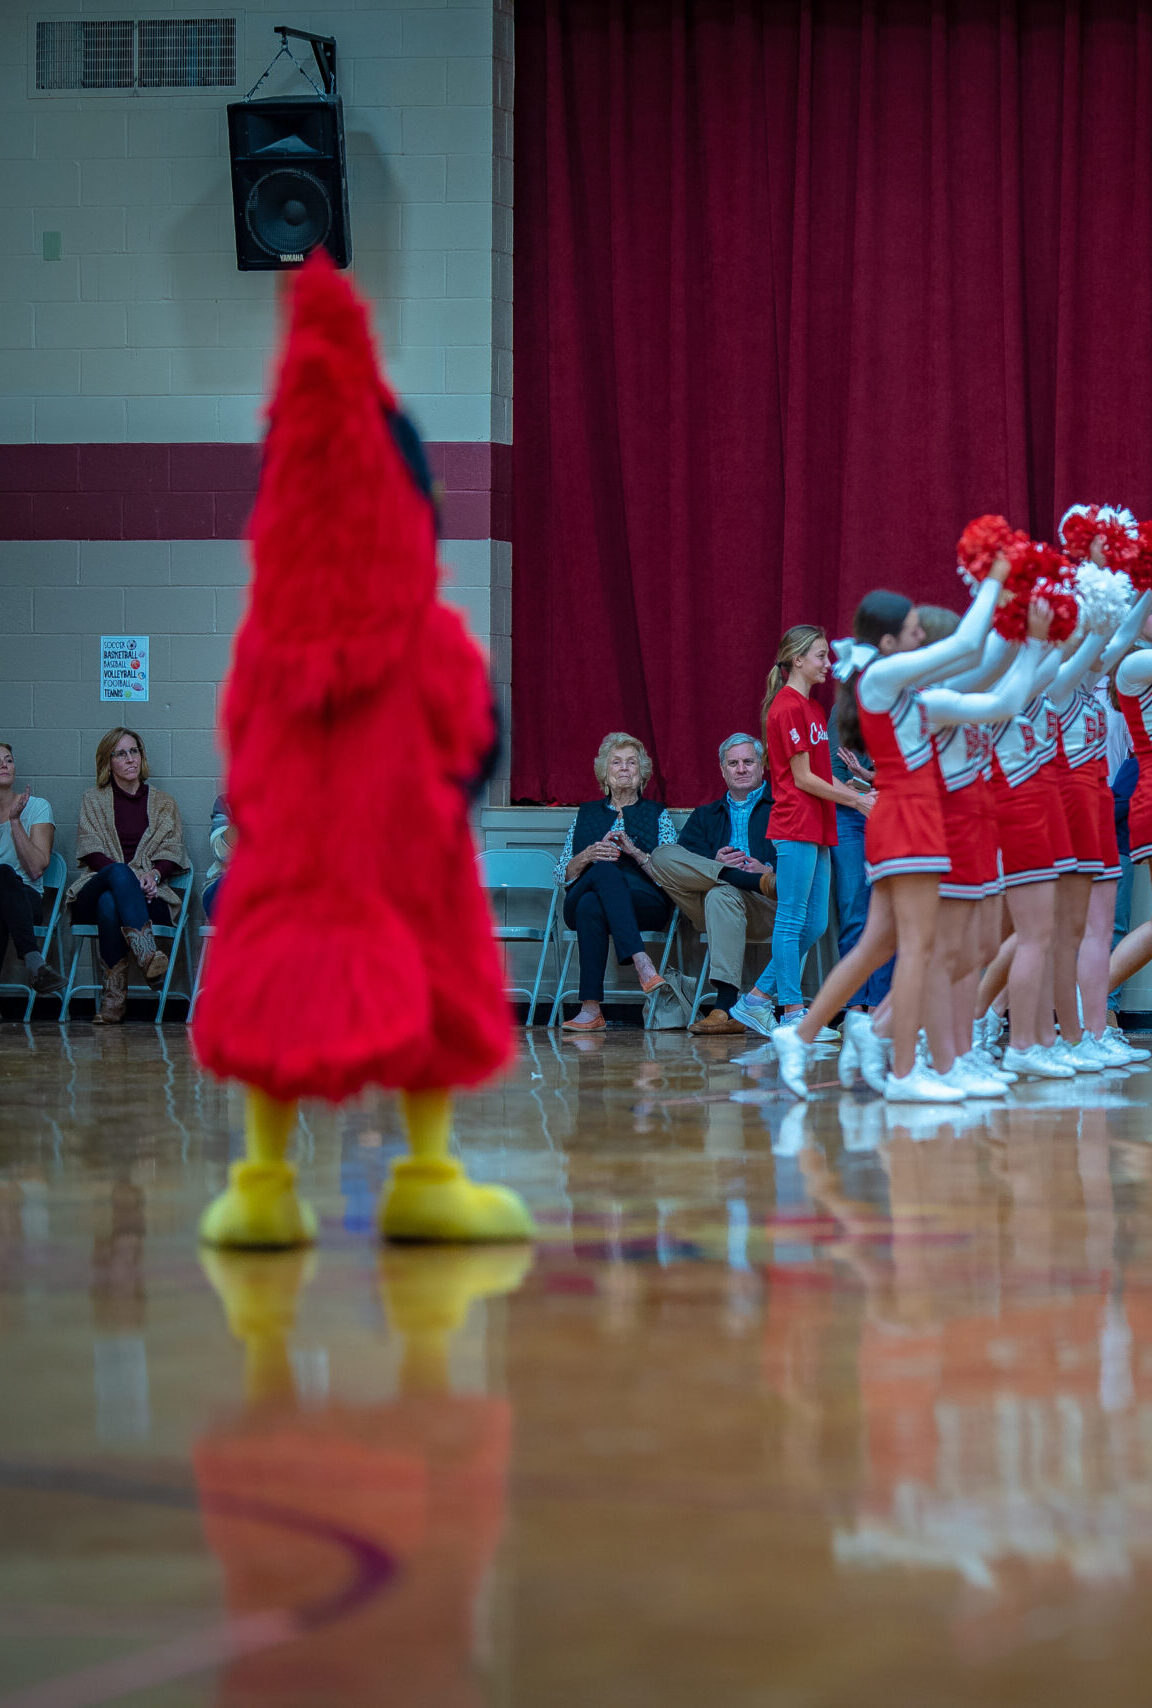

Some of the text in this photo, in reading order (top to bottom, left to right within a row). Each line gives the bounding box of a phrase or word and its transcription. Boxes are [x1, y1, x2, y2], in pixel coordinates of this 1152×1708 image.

[280, 254, 304, 262] YAMAHA
[104, 651, 138, 659] BASKETBALL
[104, 660, 126, 668] BASEBALL
[104, 670, 137, 678] VOLLEYBALL
[104, 689, 123, 697] TENNIS
